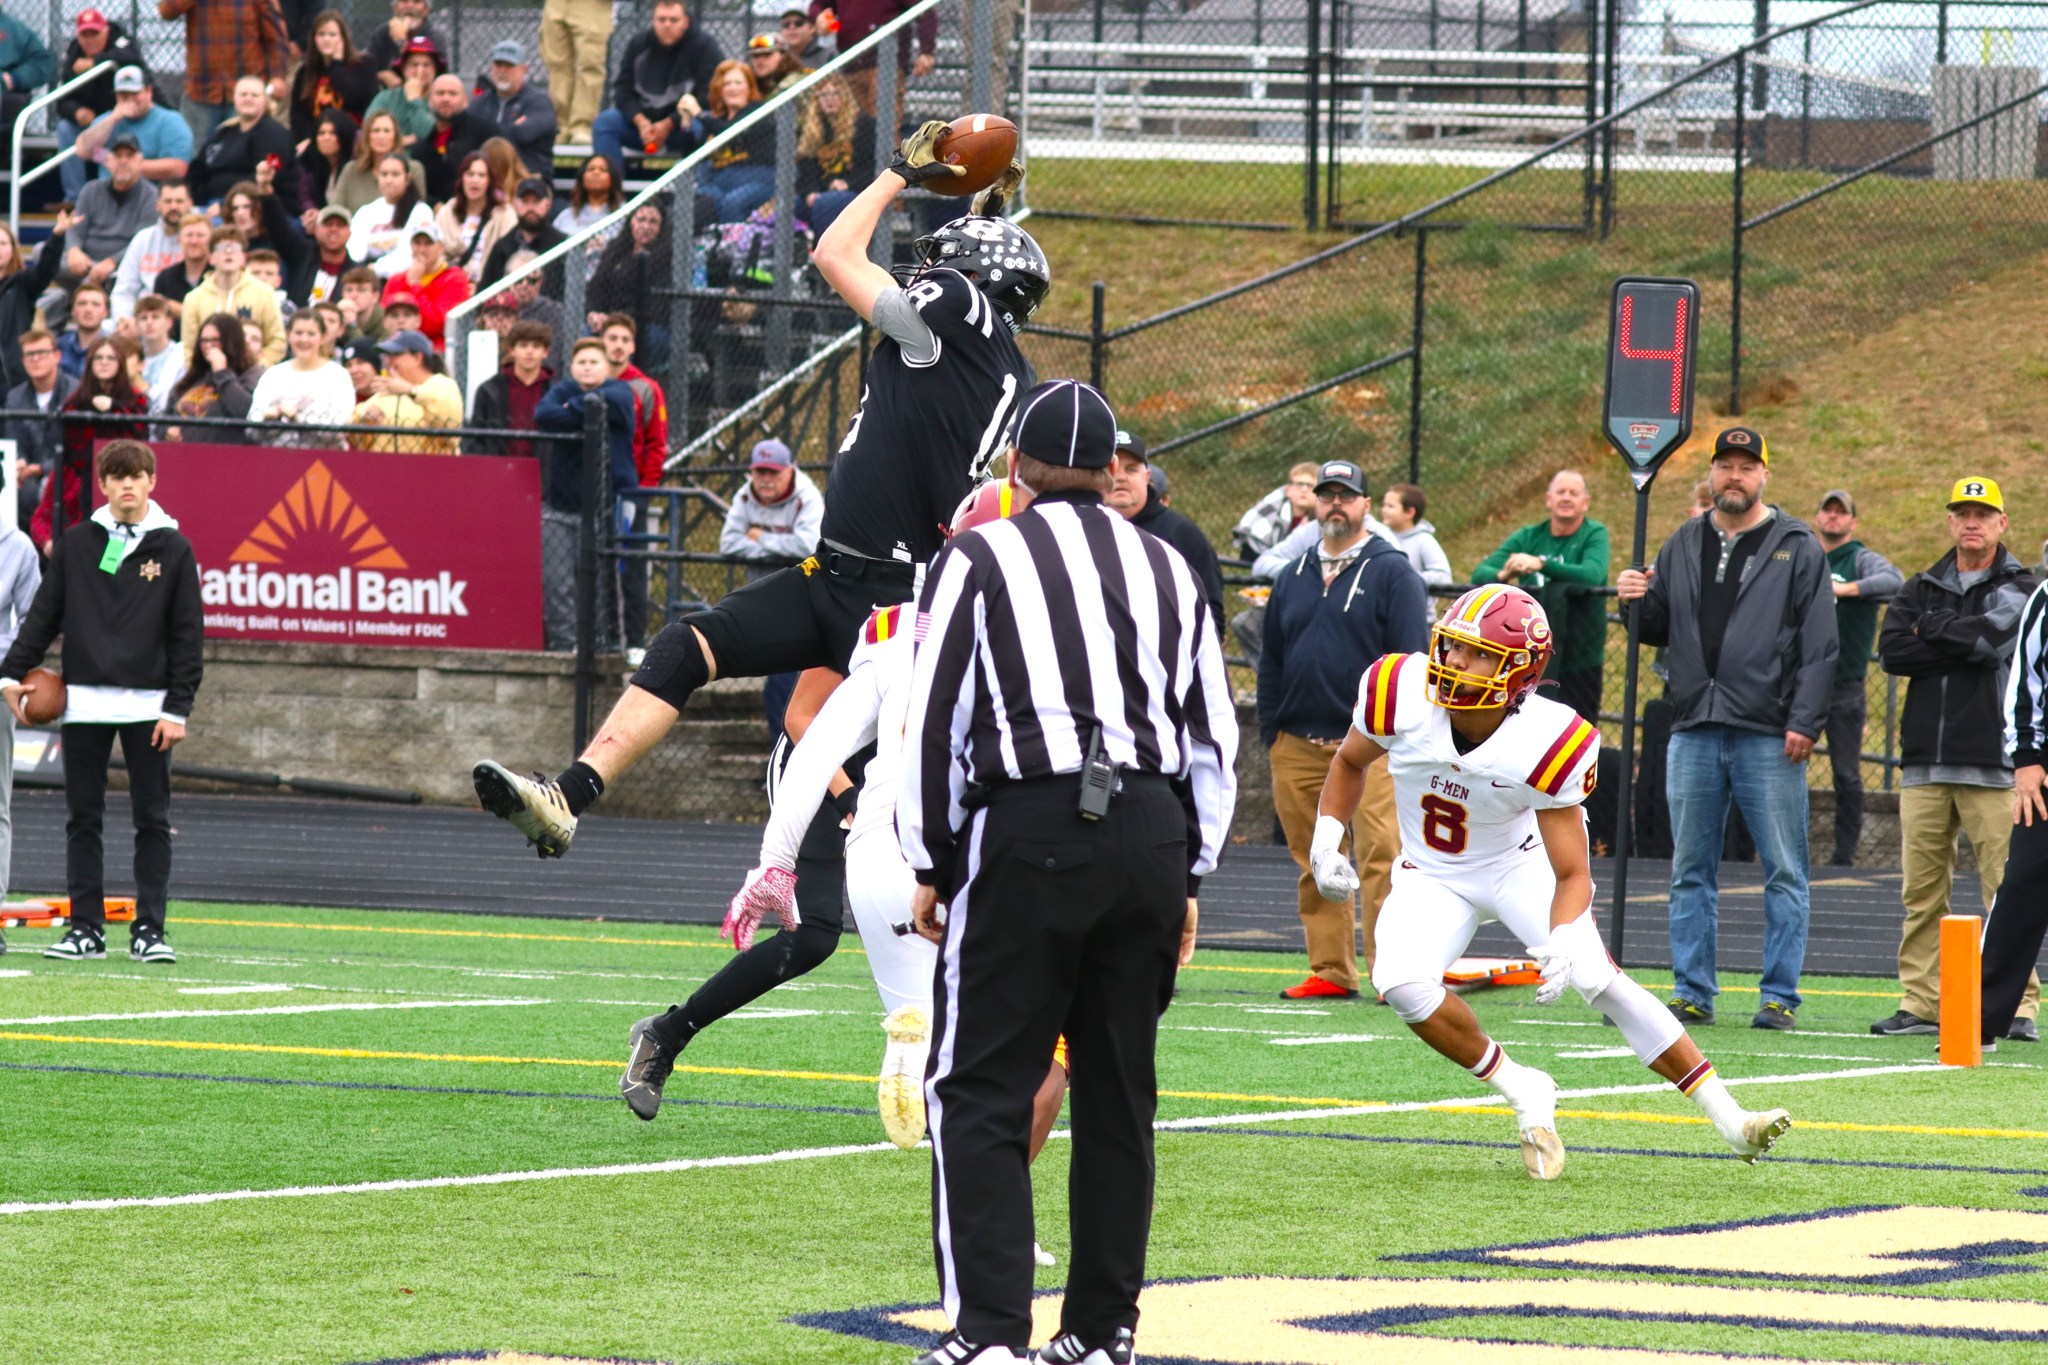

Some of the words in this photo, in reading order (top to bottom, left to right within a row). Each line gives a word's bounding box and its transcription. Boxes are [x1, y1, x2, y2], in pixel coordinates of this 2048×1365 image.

[1620, 295, 1687, 414] 4
[1963, 483, 1985, 496] R
[896, 540, 908, 550] XL
[196, 562, 351, 611] ational
[357, 570, 469, 616] Bank
[203, 612, 246, 632] anking
[248, 614, 279, 631] Built
[281, 618, 300, 631] on
[301, 617, 347, 634] Values
[355, 620, 412, 636] Member
[414, 622, 448, 638] FDIC
[1452, 620, 1477, 633] Riddell
[1430, 775, 1470, 801] G-MEN
[1582, 760, 1598, 796] 8
[1419, 792, 1470, 855] 8
